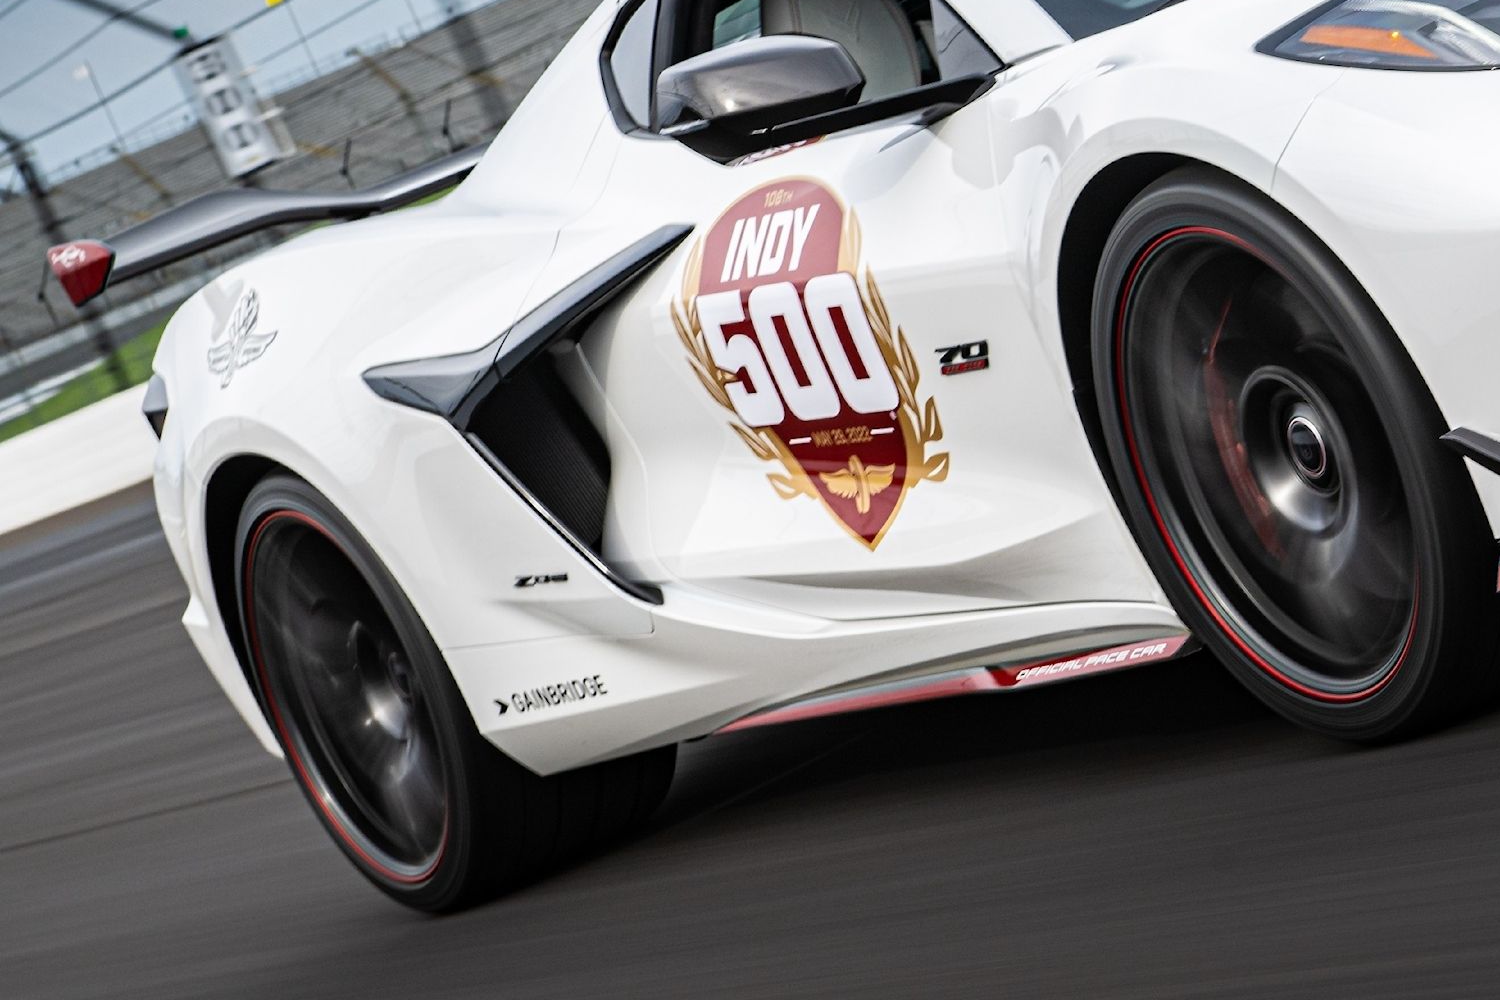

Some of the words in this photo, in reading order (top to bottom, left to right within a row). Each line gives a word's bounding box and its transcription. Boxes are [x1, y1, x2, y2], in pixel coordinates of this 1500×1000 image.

[719, 203, 821, 283] INDY
[695, 270, 900, 428] 500
[934, 339, 989, 364] 70
[1015, 659, 1084, 681] OFFICIAL
[1083, 649, 1131, 669] PACE
[1129, 642, 1168, 660] CAR
[511, 674, 608, 713] GAINBRIDGE
